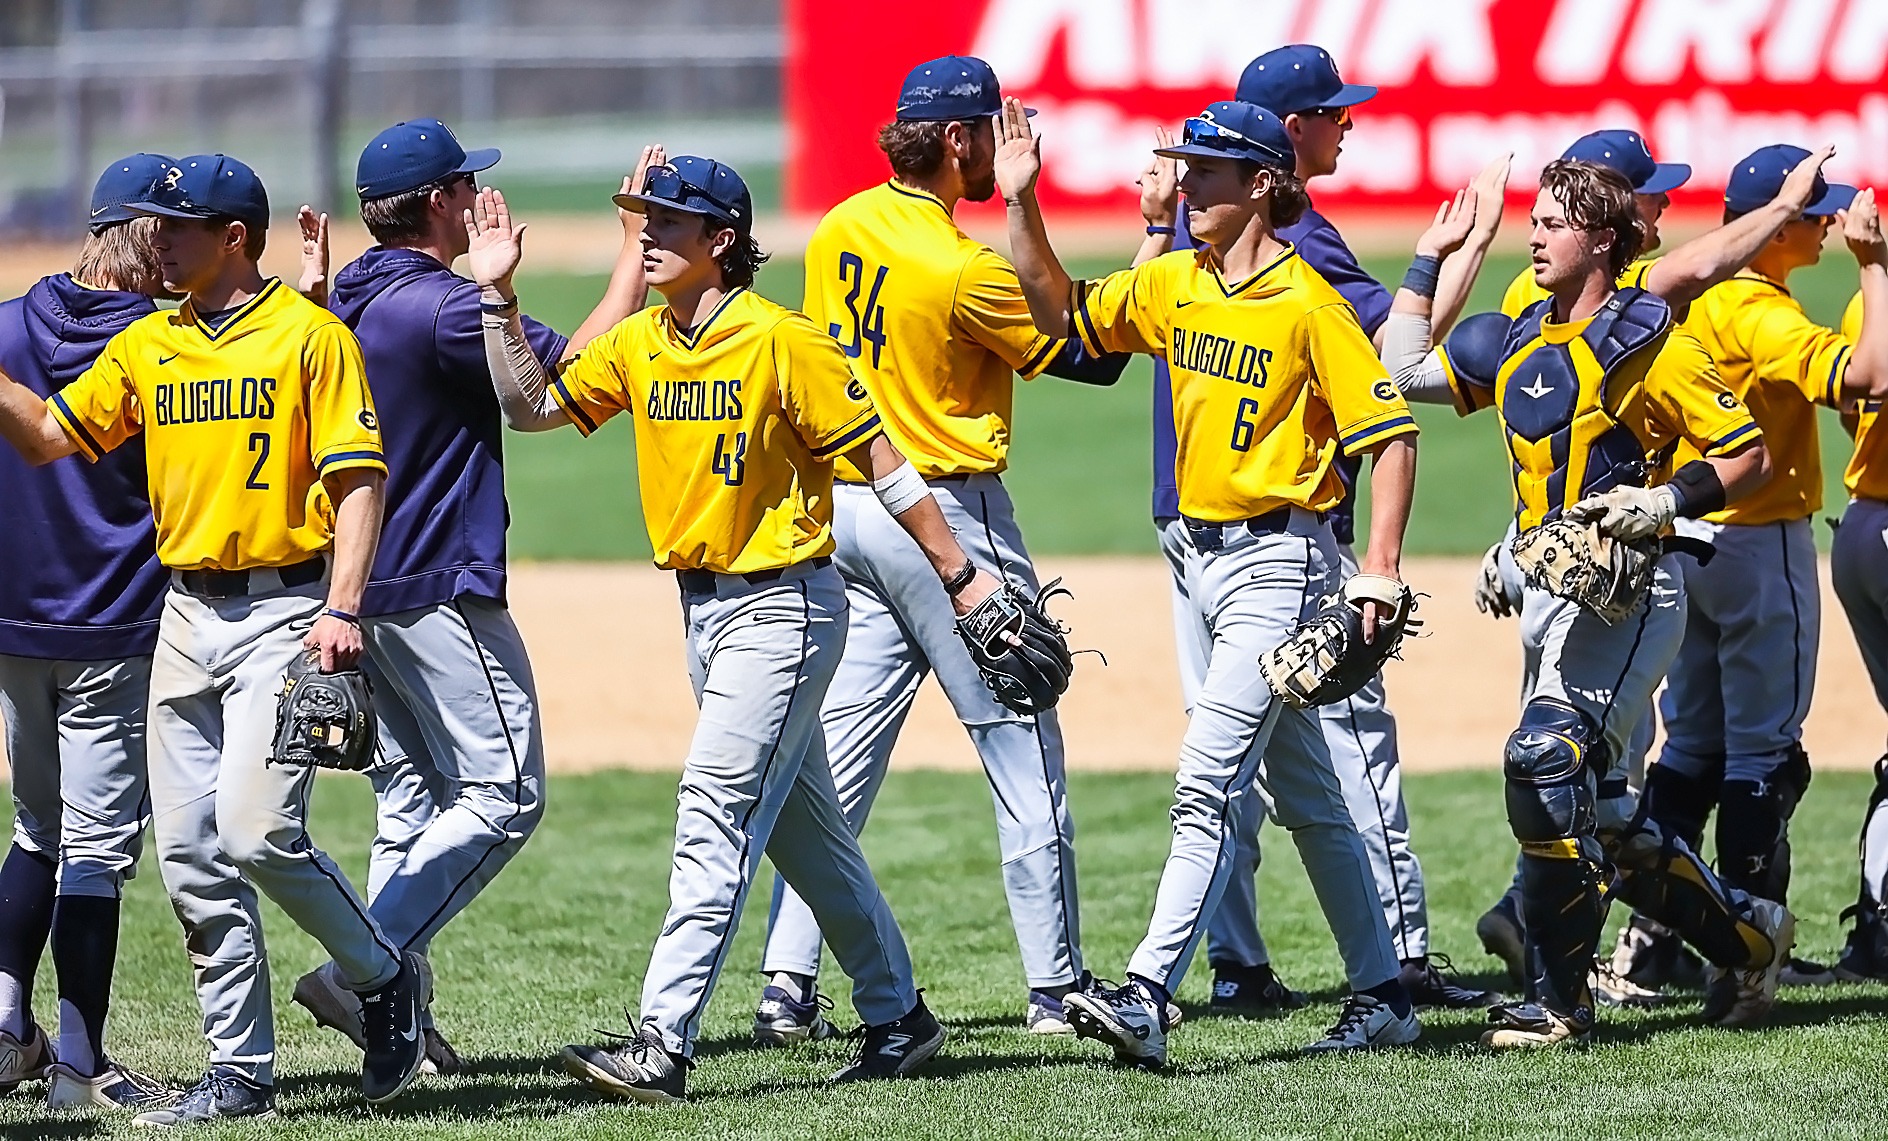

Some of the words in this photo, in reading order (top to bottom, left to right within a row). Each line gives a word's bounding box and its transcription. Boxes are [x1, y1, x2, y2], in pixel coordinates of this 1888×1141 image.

[829, 251, 889, 370] 34
[1173, 326, 1273, 389] BLUGOLDS
[156, 377, 276, 426] BLUGOLDS
[647, 380, 743, 421] BLUGOLDS
[1230, 397, 1258, 453] 6
[245, 432, 271, 490] 2
[711, 431, 746, 487] 43
[365, 993, 382, 1003] NIKE
